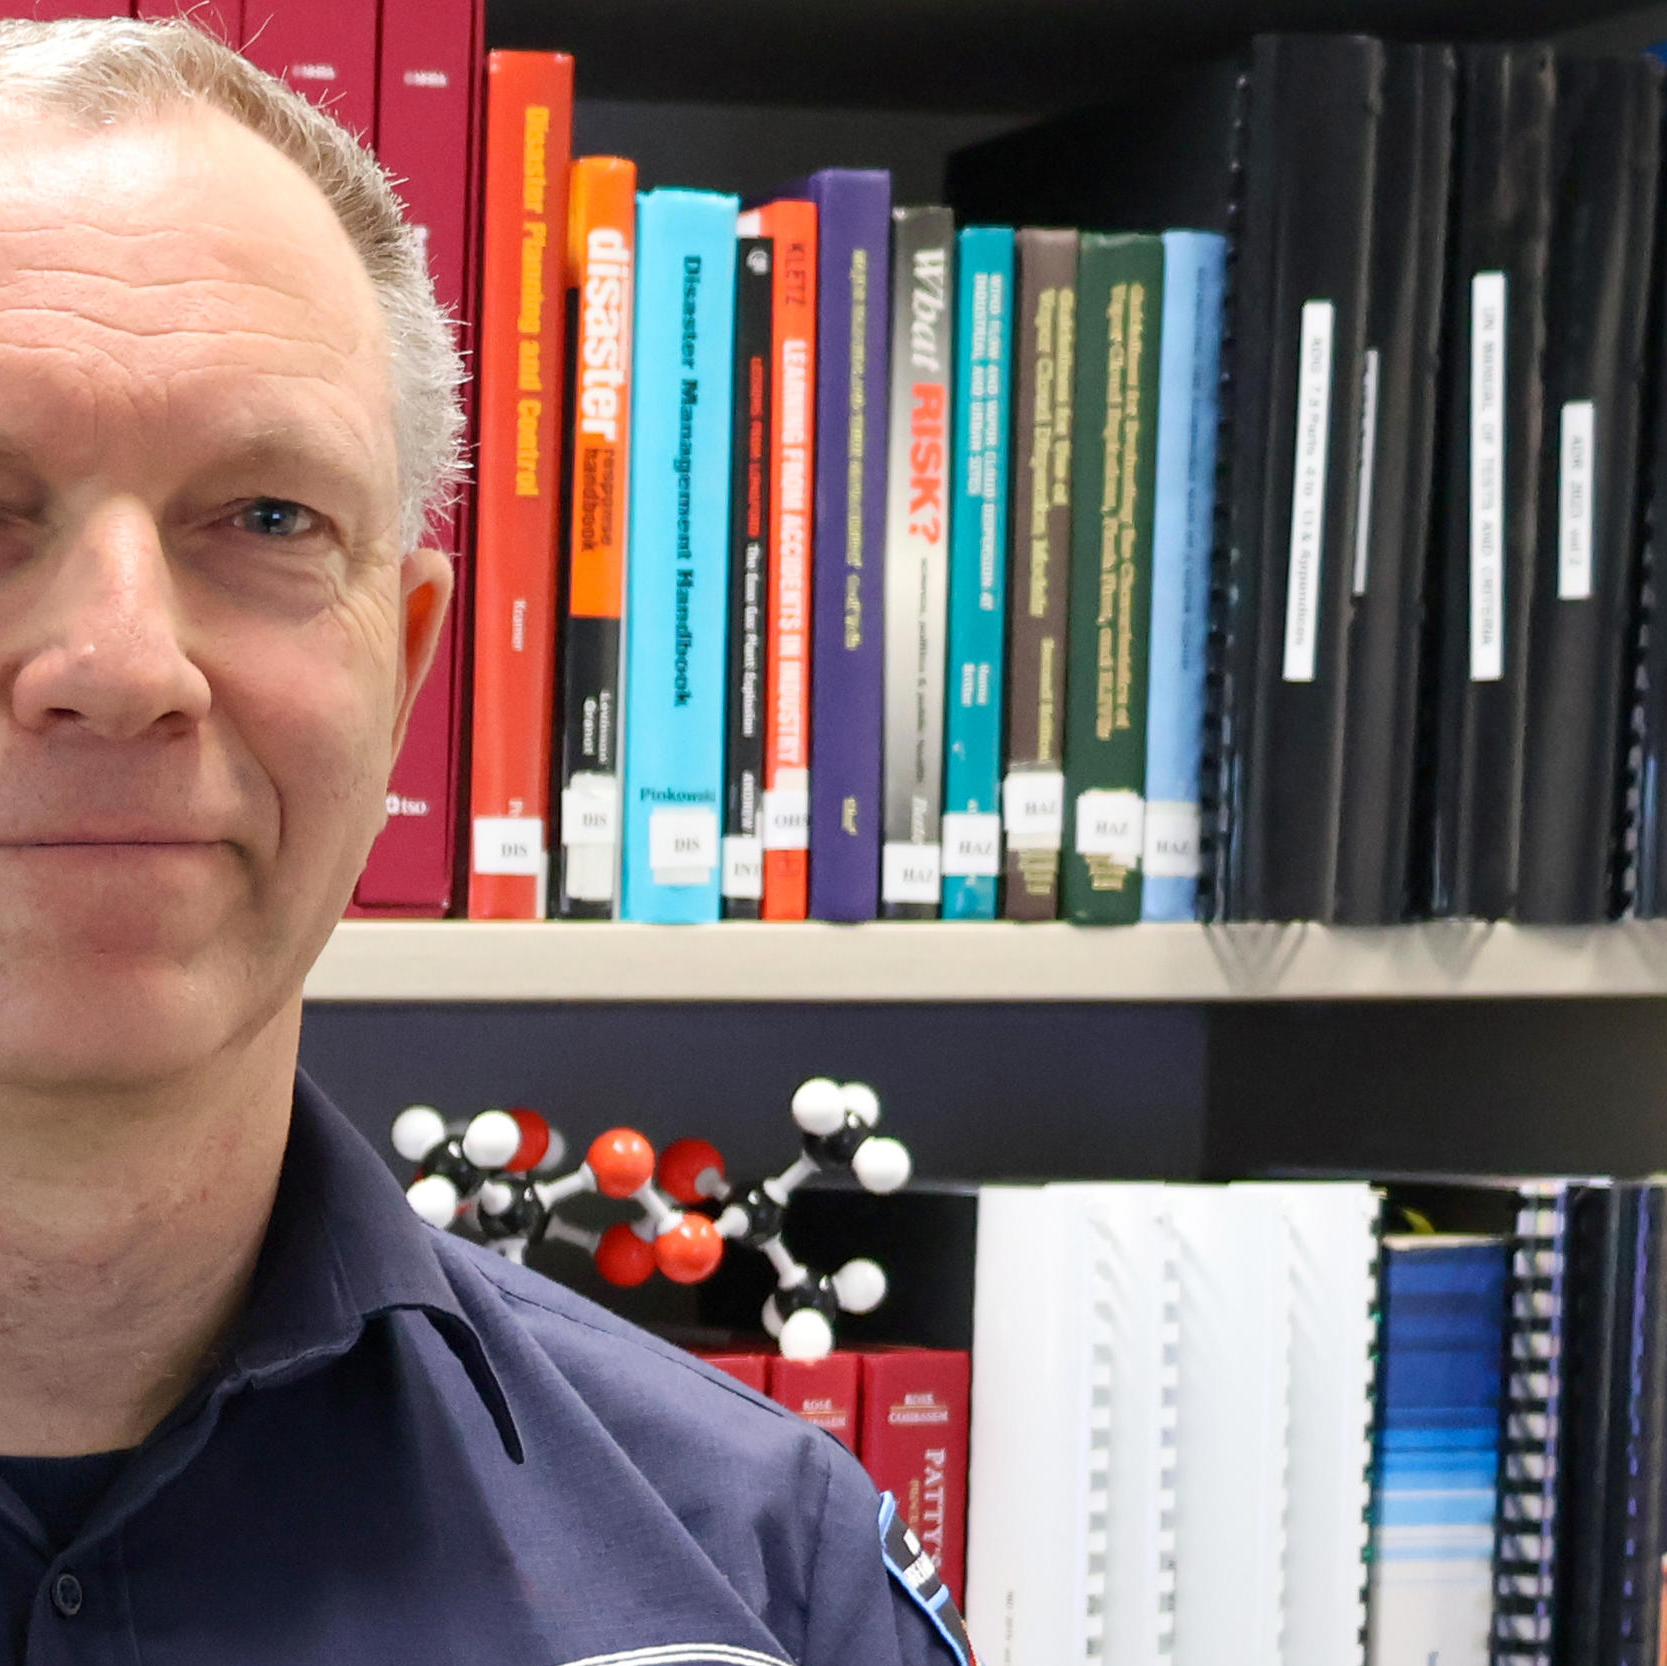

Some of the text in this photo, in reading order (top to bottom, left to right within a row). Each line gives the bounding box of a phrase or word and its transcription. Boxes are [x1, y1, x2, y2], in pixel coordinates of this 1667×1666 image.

[516, 107, 550, 496] Disaster Planning and Control
[581, 228, 627, 442] disaster
[909, 248, 947, 372] What
[672, 255, 702, 707] Disaster Management Handbook
[908, 382, 946, 545] RISK?
